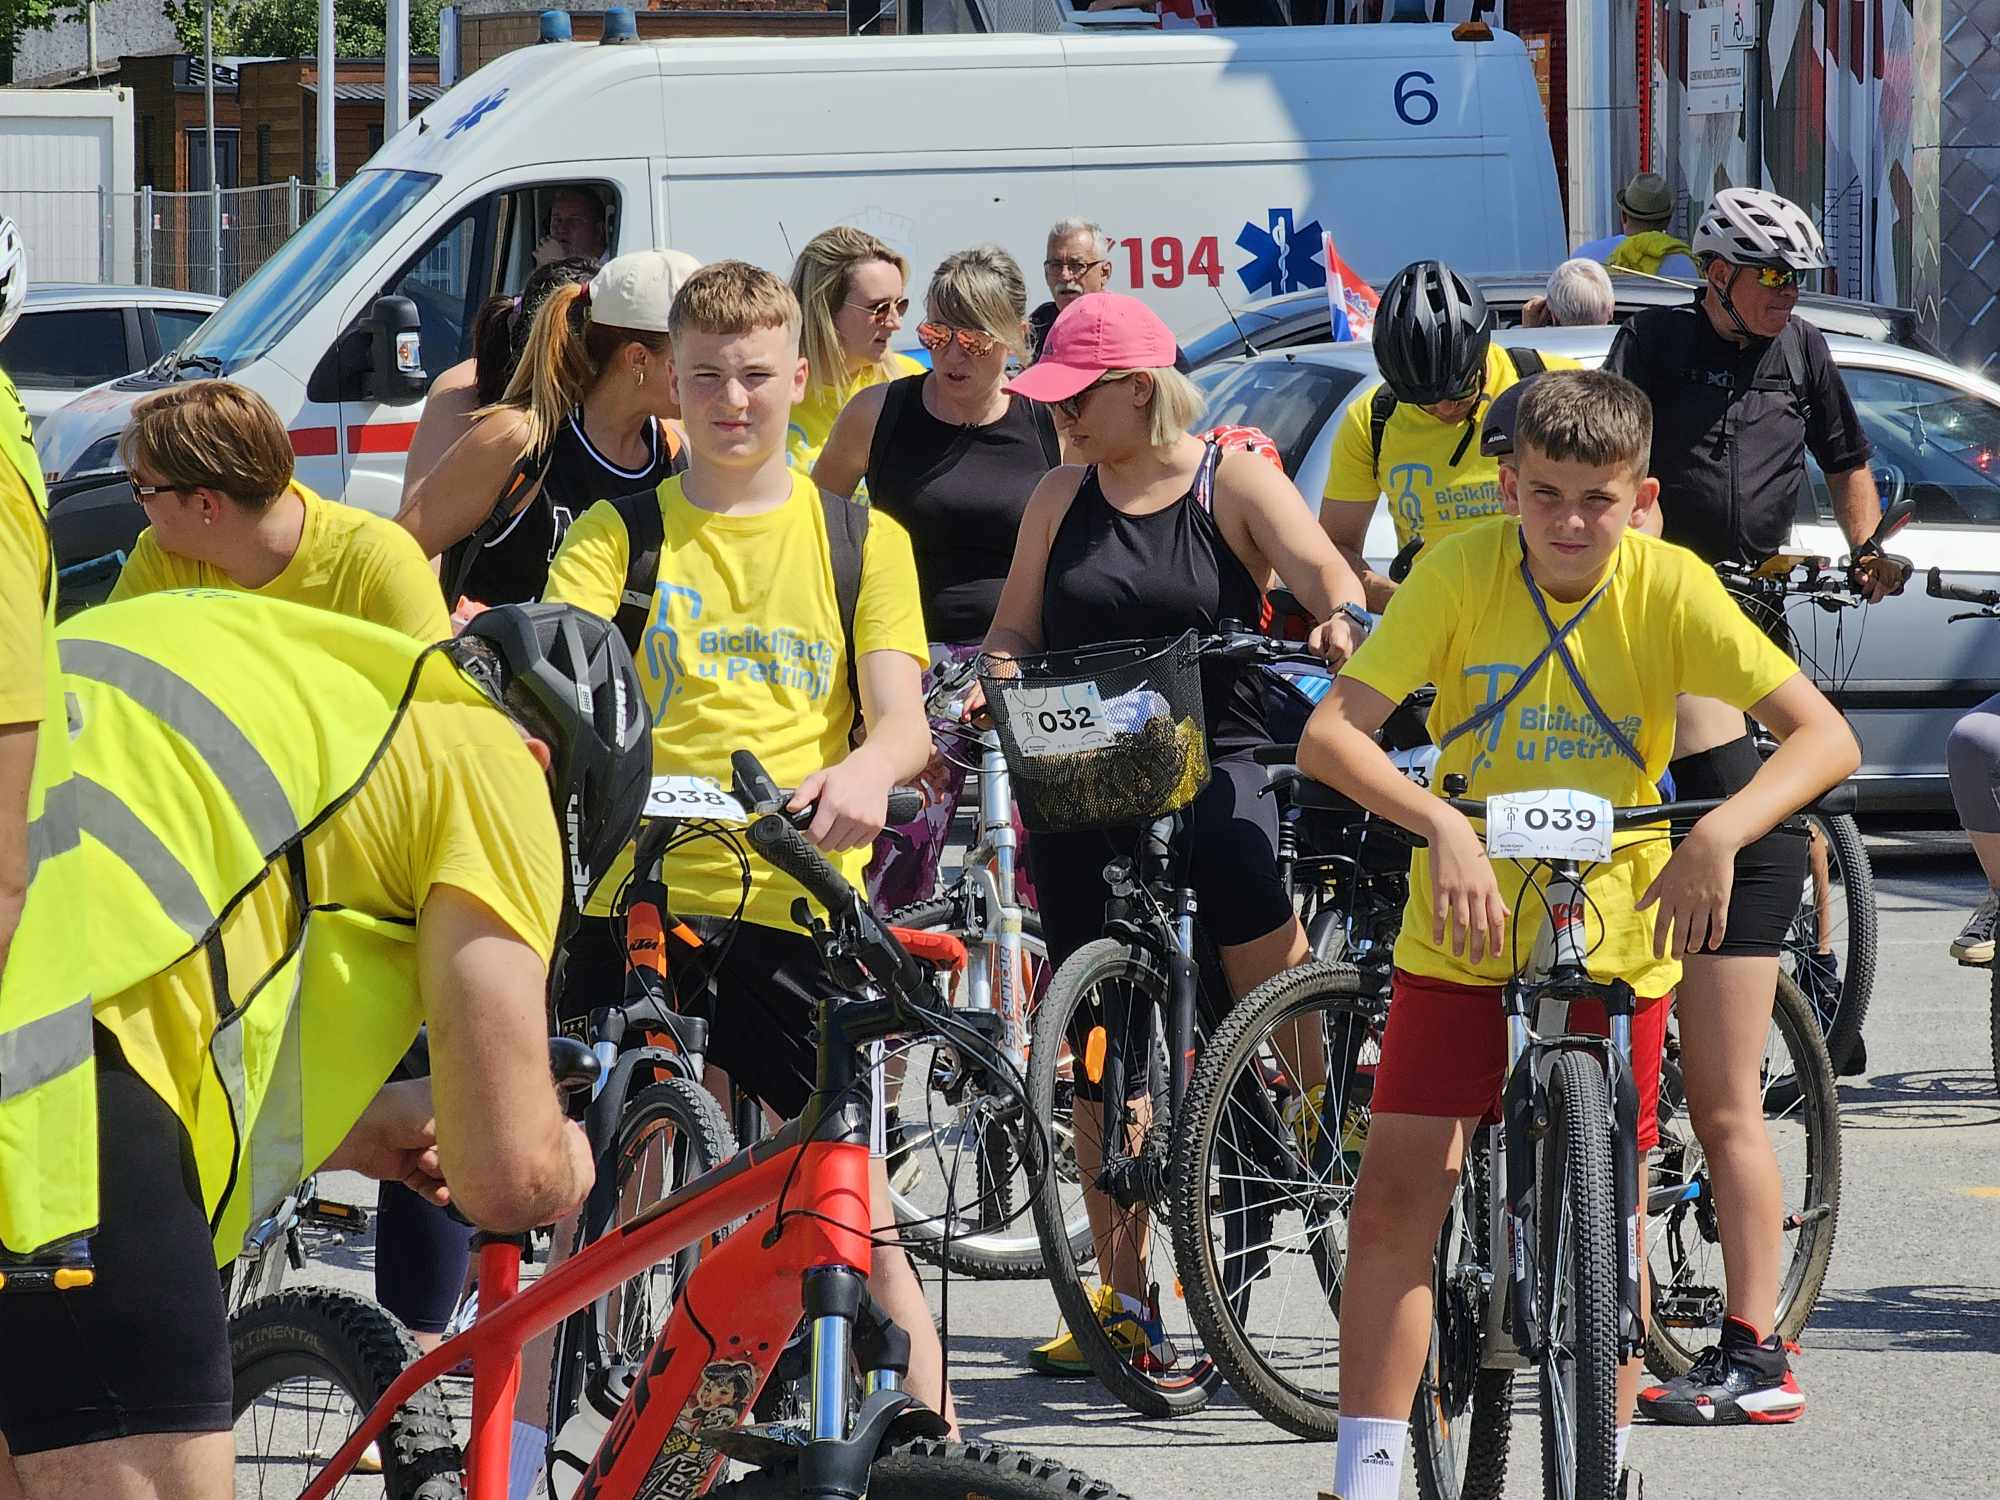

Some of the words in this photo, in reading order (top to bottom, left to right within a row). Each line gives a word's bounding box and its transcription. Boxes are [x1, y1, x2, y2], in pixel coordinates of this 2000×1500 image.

[1394, 71, 1439, 125] 6
[1120, 236, 1225, 289] 194
[700, 625, 832, 663] Biciklijada
[698, 662, 717, 678] u
[727, 656, 830, 700] Petrinji
[614, 679, 627, 748] LIMAR
[1038, 706, 1096, 733] 032
[1516, 738, 1536, 761] u
[651, 790, 726, 806] 038
[1524, 808, 1597, 832] 039
